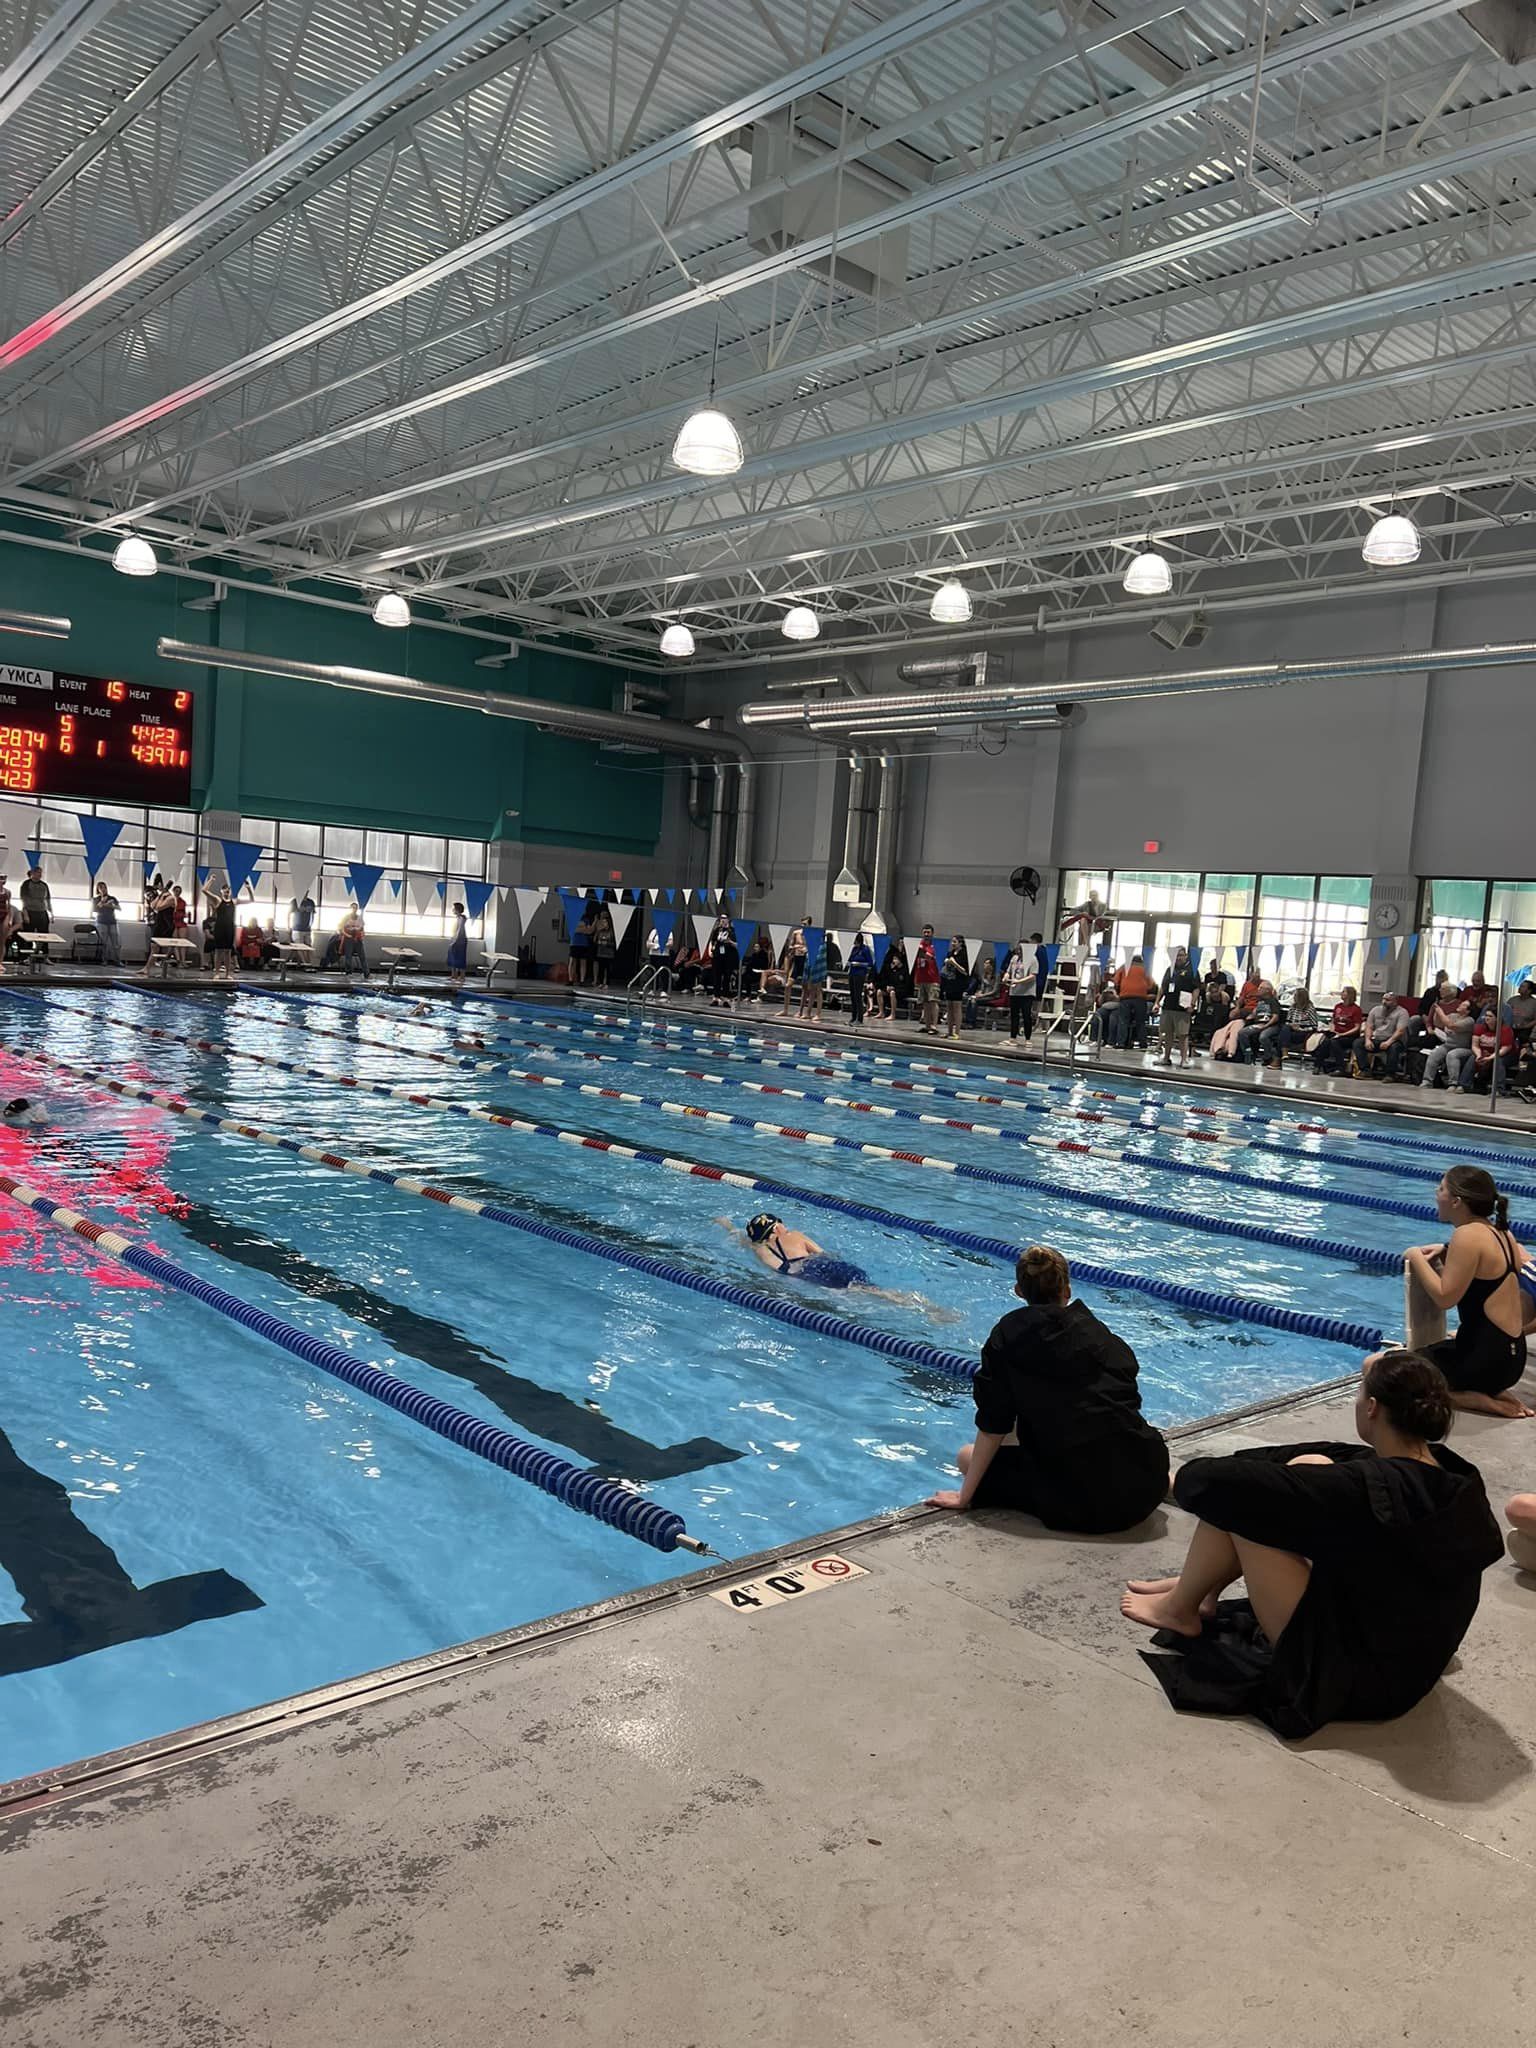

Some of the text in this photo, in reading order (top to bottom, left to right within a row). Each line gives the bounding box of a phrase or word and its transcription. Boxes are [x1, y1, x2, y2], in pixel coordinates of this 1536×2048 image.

[7, 668, 42, 685] YMCA
[0, 694, 17, 705] IME
[59, 679, 187, 709] EVENT 15 HEAT 2
[55, 702, 111, 717] LANE PLACE
[61, 715, 72, 732] 5
[140, 714, 161, 724] TIME
[60, 736, 72, 753] 6
[97, 740, 105, 756] 1
[784, 1568, 805, 1580] IN
[742, 1583, 761, 1594] FT
[728, 1589, 763, 1608] 4
